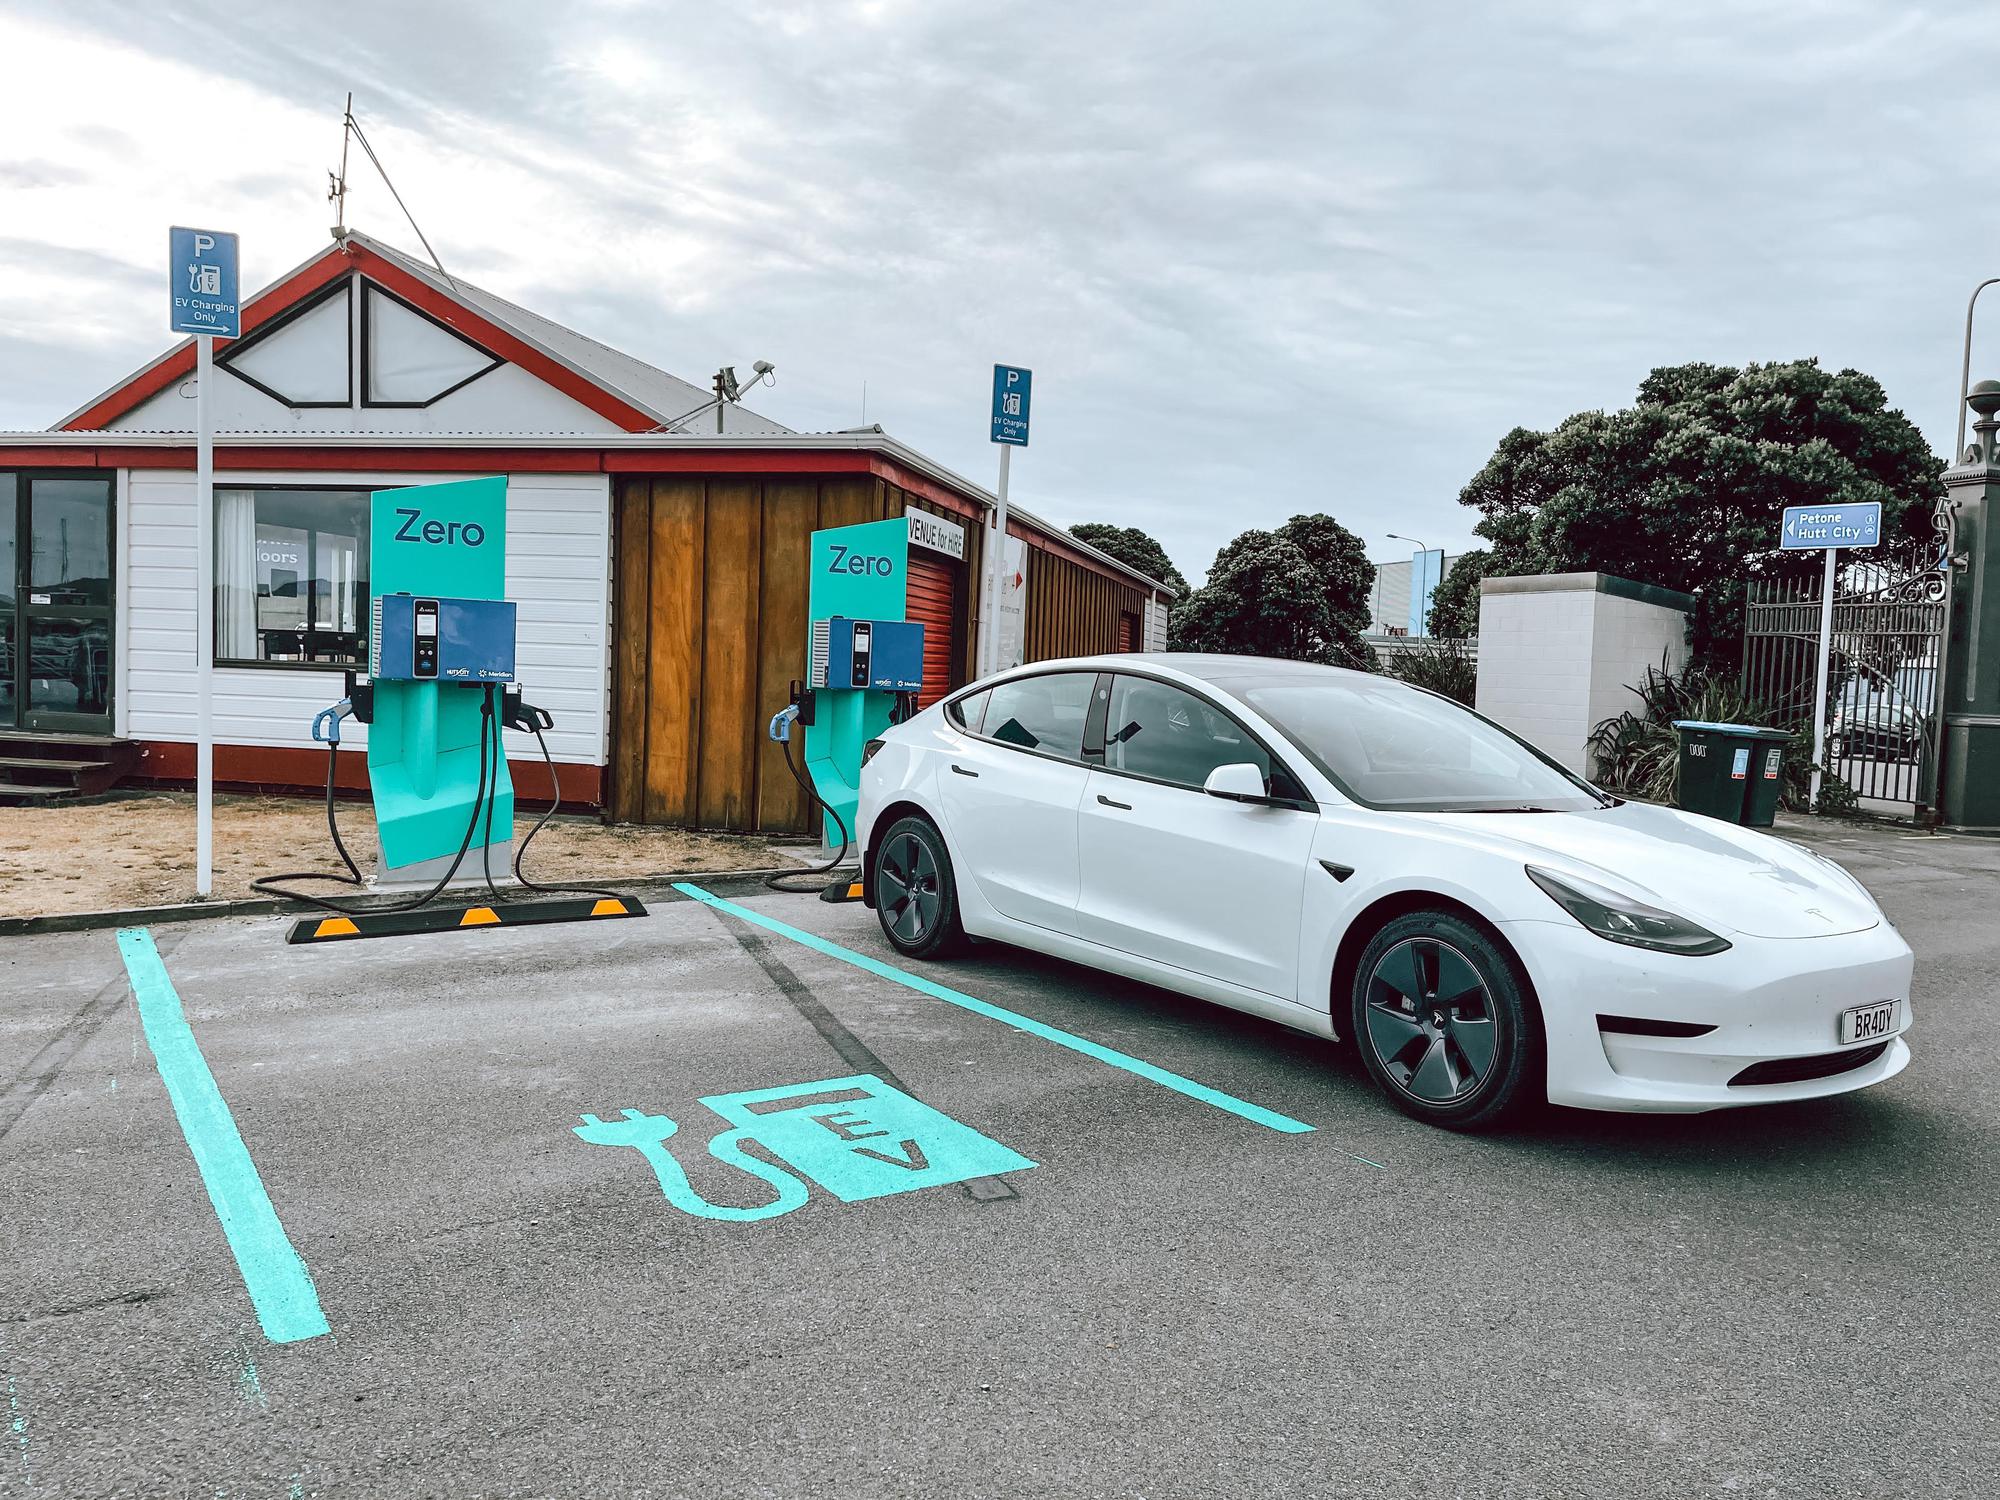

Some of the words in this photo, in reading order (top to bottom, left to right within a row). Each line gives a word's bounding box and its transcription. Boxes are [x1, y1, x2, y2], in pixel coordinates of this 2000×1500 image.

[194, 234, 215, 258] P
[175, 297, 189, 307] EV
[191, 299, 235, 313] Charging
[194, 311, 216, 324] Only
[1007, 370, 1019, 388] P
[994, 416, 1002, 424] EV
[1002, 417, 1027, 429] Charging
[1003, 426, 1017, 436] Only
[1799, 512, 1842, 525] Petone
[394, 507, 485, 547] Zero
[1798, 527, 1827, 539] Hutt
[1833, 526, 1861, 540] City
[909, 516, 937, 546] VENUE
[937, 527, 947, 549] for
[947, 531, 962, 555] HIRE
[257, 548, 298, 563] oors
[828, 544, 893, 577] Zero
[1854, 1007, 1893, 1039] BR4DY
